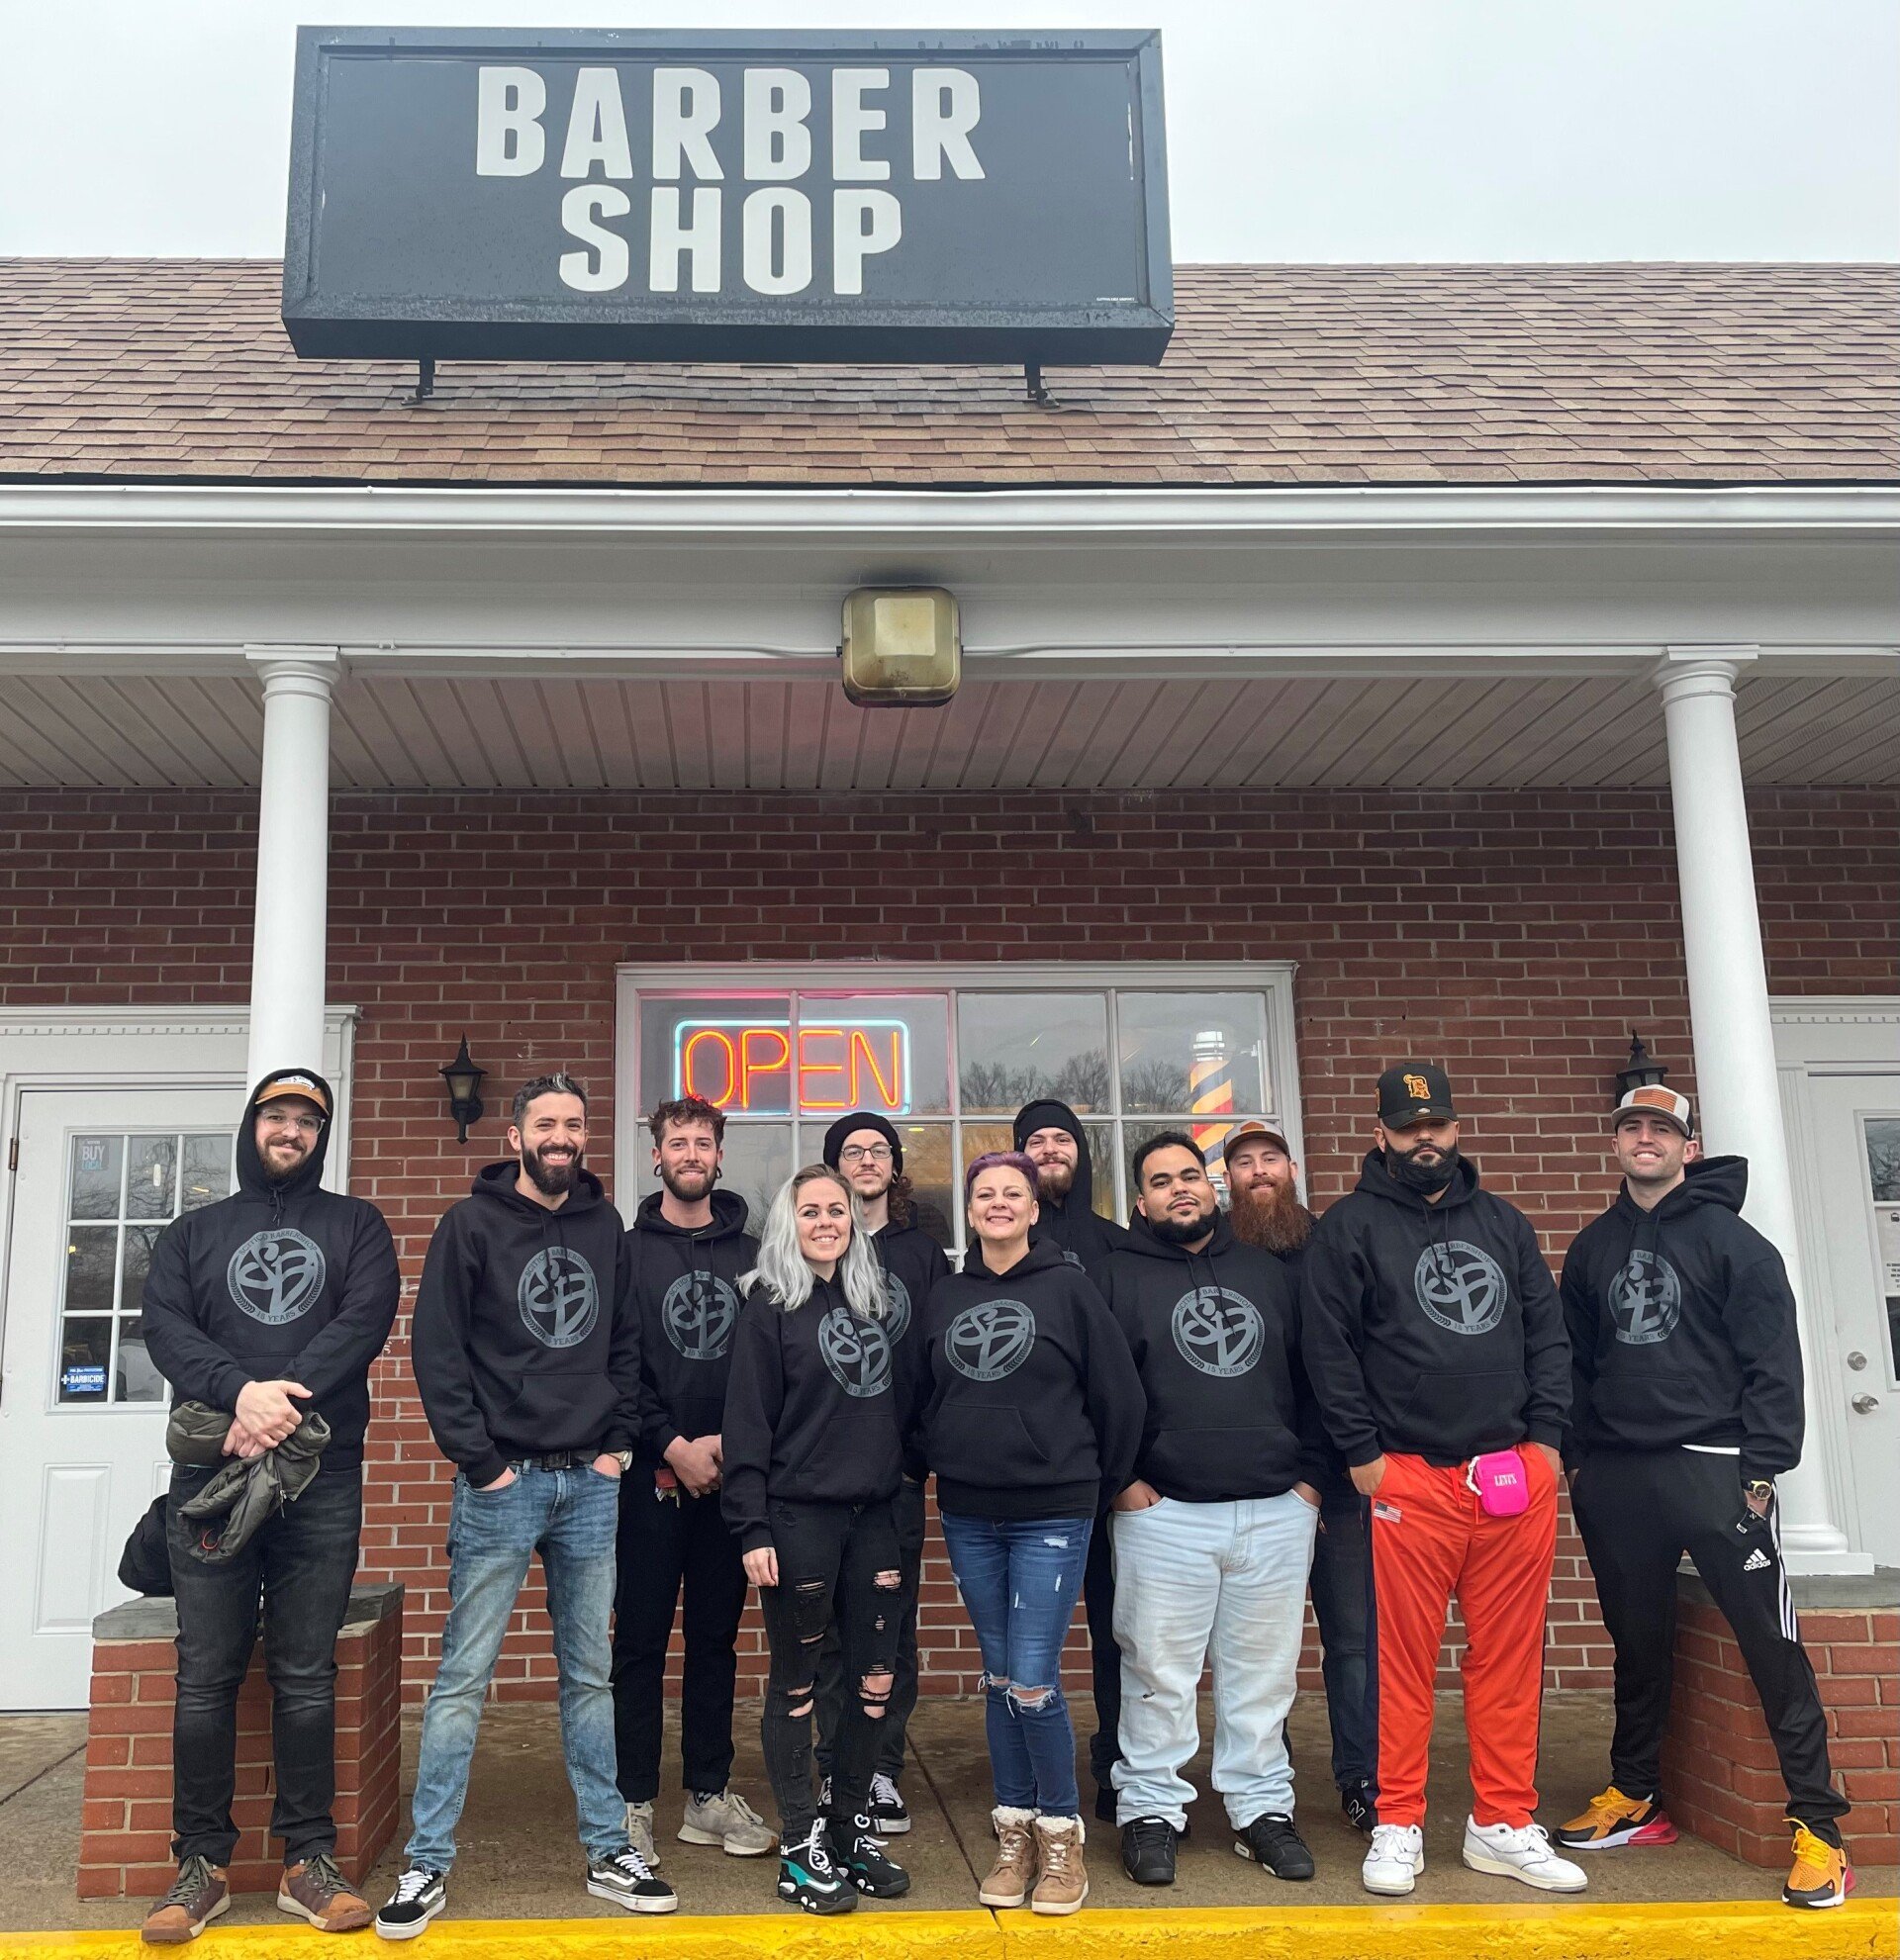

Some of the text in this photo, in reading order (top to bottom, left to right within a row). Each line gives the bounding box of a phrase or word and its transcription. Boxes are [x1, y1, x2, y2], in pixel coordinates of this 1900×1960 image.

[476, 66, 986, 180] BARBER
[559, 184, 902, 295] SHOP
[684, 1029, 899, 1109] OPEN
[82, 1145, 105, 1161] BUY
[267, 1310, 296, 1322] YEARS
[976, 1369, 1001, 1379] YEARS
[1207, 1364, 1244, 1375] 15 YEARS
[1743, 1559, 1771, 1571] adidas
